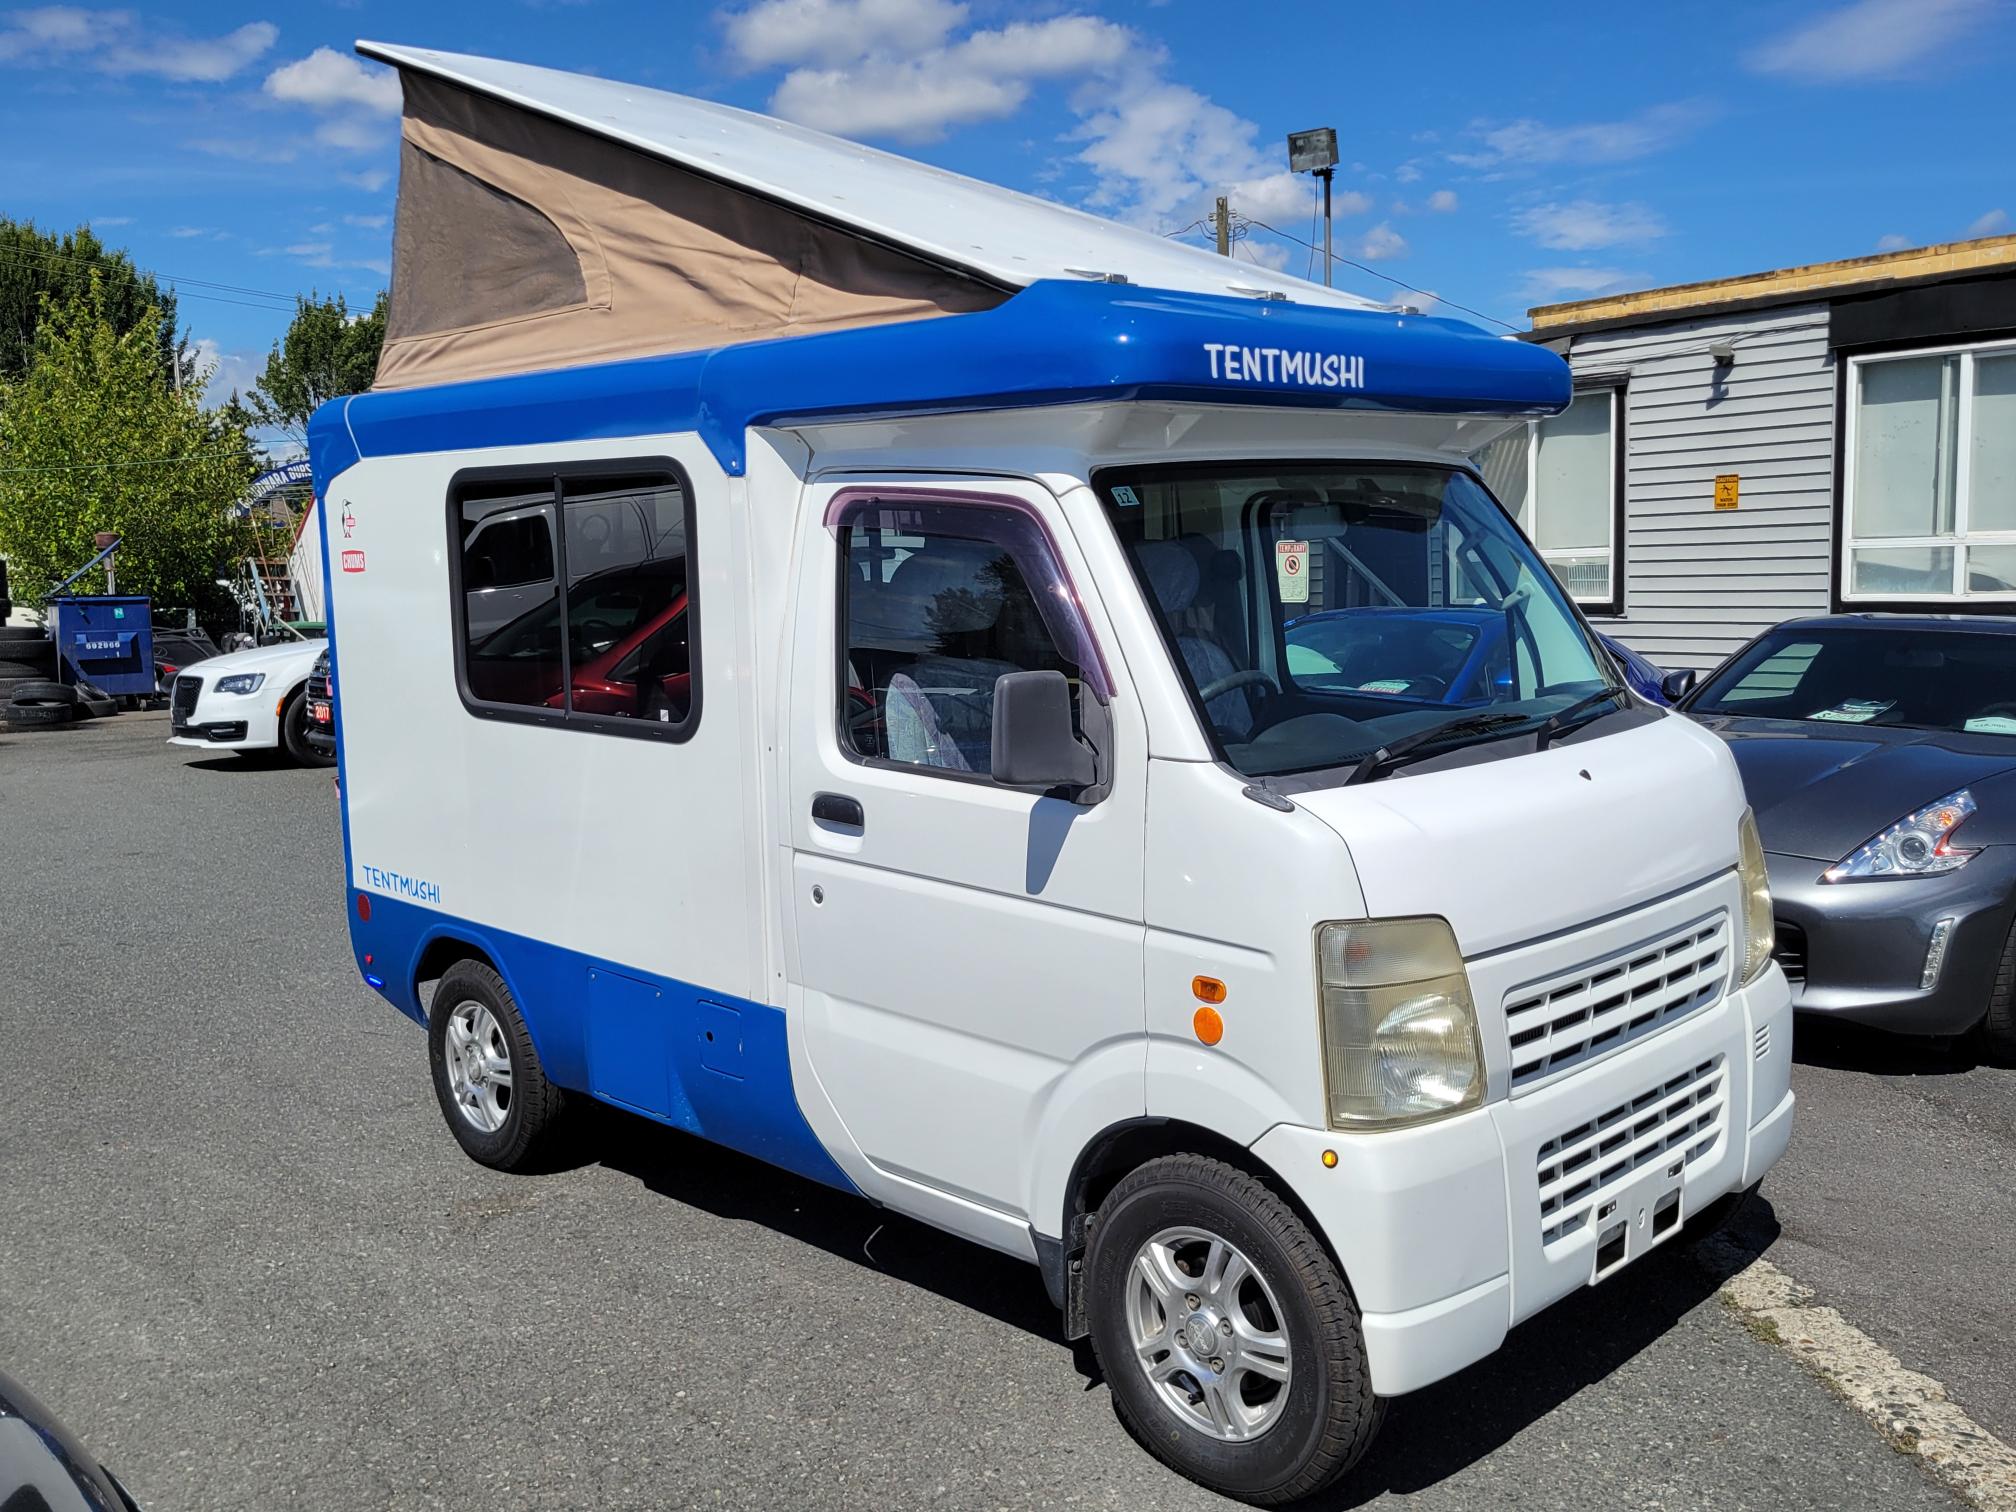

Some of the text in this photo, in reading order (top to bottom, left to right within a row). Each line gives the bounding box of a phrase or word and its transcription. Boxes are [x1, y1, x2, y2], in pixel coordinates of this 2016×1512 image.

[1203, 344, 1365, 389] TENTMUSHI
[1117, 492, 1132, 504] 12
[343, 553, 364, 568] CHUMS
[315, 706, 330, 720] 2017
[362, 865, 441, 904] TENTMUSHI
